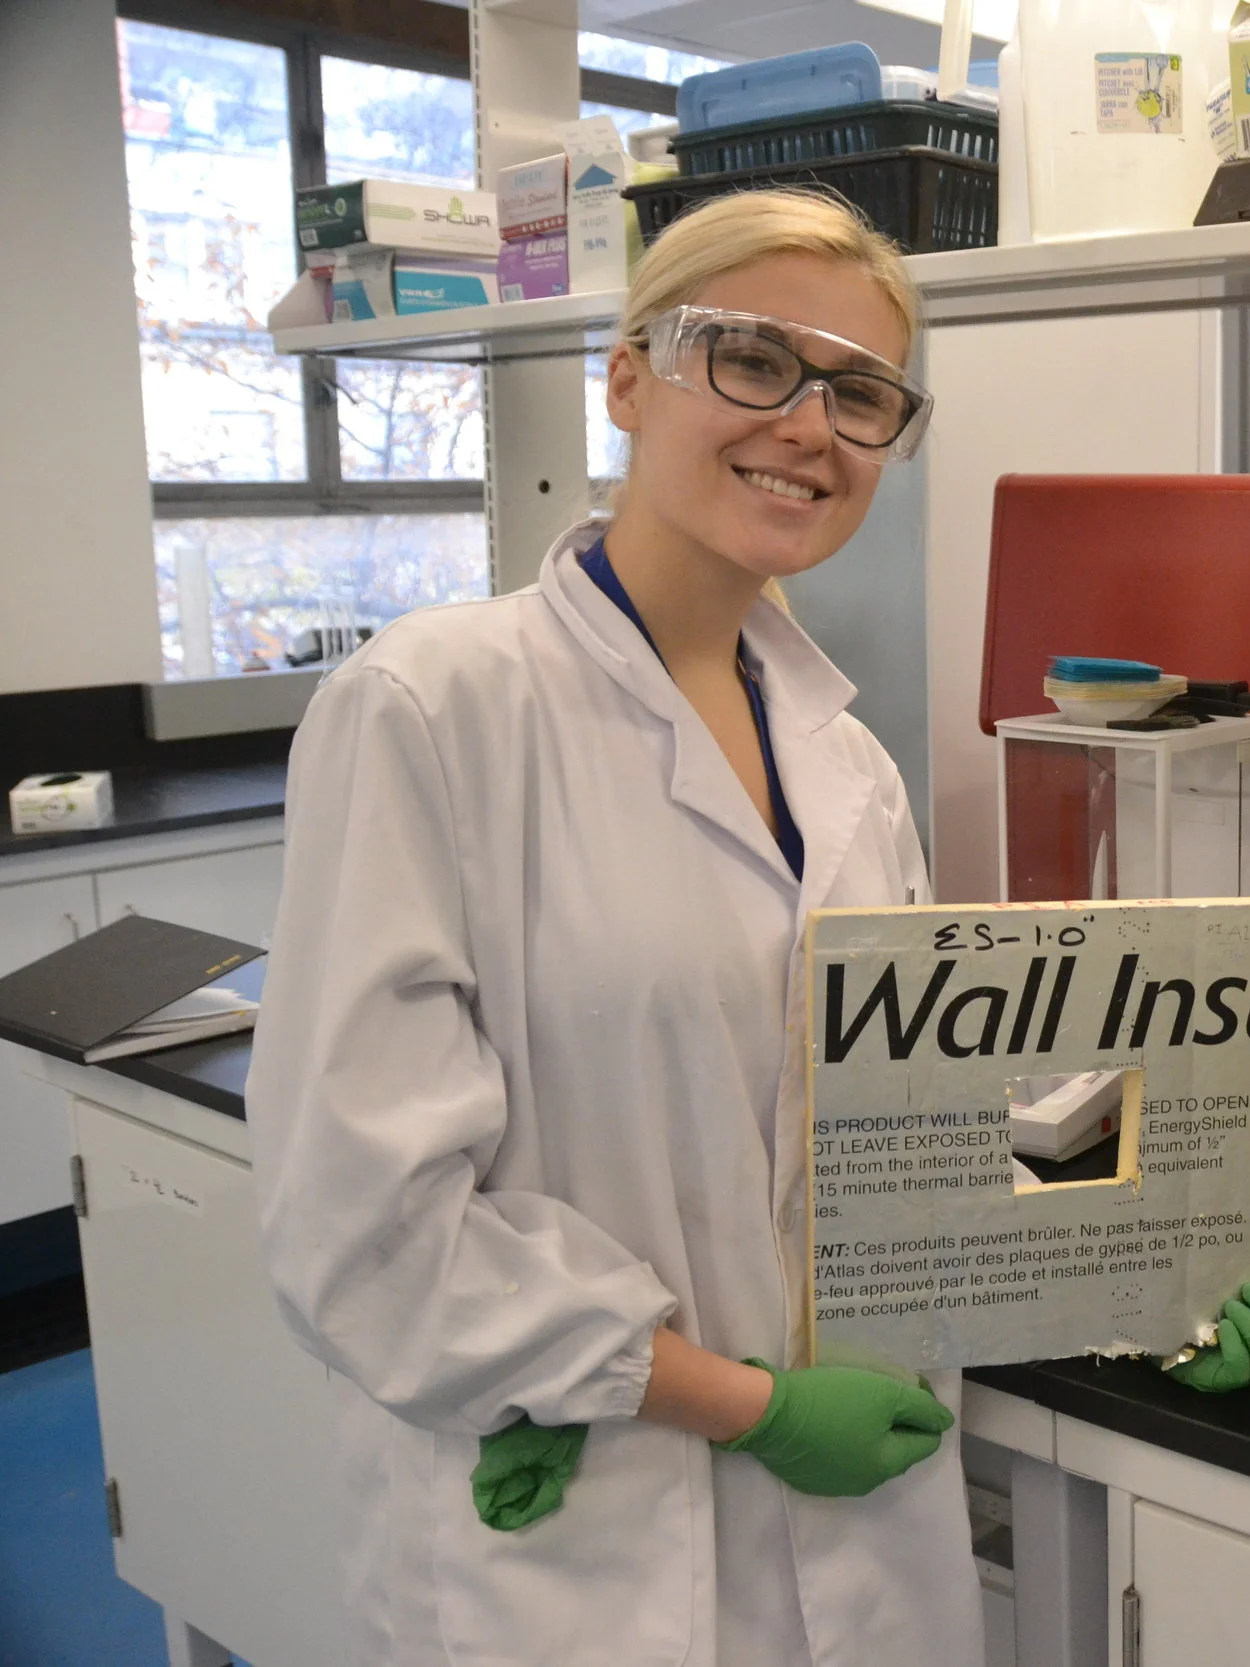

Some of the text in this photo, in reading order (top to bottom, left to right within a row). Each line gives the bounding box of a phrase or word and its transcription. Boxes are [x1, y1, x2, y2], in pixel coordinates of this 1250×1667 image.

[424, 208, 491, 228] SHOWA
[824, 955, 1077, 1063] Wall
[835, 1115, 926, 1133] PRODUCT
[930, 1112, 972, 1128] WILL
[1176, 1097, 1199, 1113] TO
[1202, 1095, 1249, 1111] OPEN
[840, 1136, 899, 1154] LEAVE
[904, 1131, 991, 1150] EXPOSED
[1149, 1114, 1248, 1135] EnergyShield
[842, 1180, 898, 1196] minute
[903, 1174, 963, 1191] thermal
[1148, 1155, 1224, 1175] equivalent
[846, 1159, 883, 1175] from
[888, 1158, 914, 1172] the
[919, 1154, 975, 1170] interior
[979, 1151, 996, 1166] of
[998, 1153, 1009, 1164] a
[1187, 1136, 1203, 1151] of
[854, 1241, 886, 1257] Ces
[891, 1236, 956, 1255] produits
[960, 1229, 1024, 1251] peuvent
[1028, 1226, 1076, 1242] brûler.
[1080, 1223, 1102, 1238] Ne
[1106, 1221, 1134, 1238] pas
[1190, 1211, 1248, 1229] exposé.
[870, 1258, 929, 1276] doivent
[933, 1254, 972, 1270] avoir
[975, 1251, 1004, 1266] des
[1009, 1247, 1071, 1266] plaques
[1074, 1242, 1094, 1257] de
[1098, 1239, 1144, 1259] gypse
[1148, 1237, 1167, 1251] de
[1172, 1233, 1194, 1249] 1/2
[1198, 1235, 1221, 1250] po,
[1225, 1232, 1244, 1244] ou
[859, 1276, 935, 1299] approuvé
[939, 1275, 966, 1291] par
[970, 1272, 984, 1286] le
[988, 1269, 1027, 1285] code
[1031, 1267, 1047, 1281] et
[1051, 1261, 1104, 1280] installé
[1109, 1258, 1148, 1274] entre
[1152, 1256, 1173, 1269] les
[815, 1288, 1043, 1321] zone occupée d'un bâtiment.
